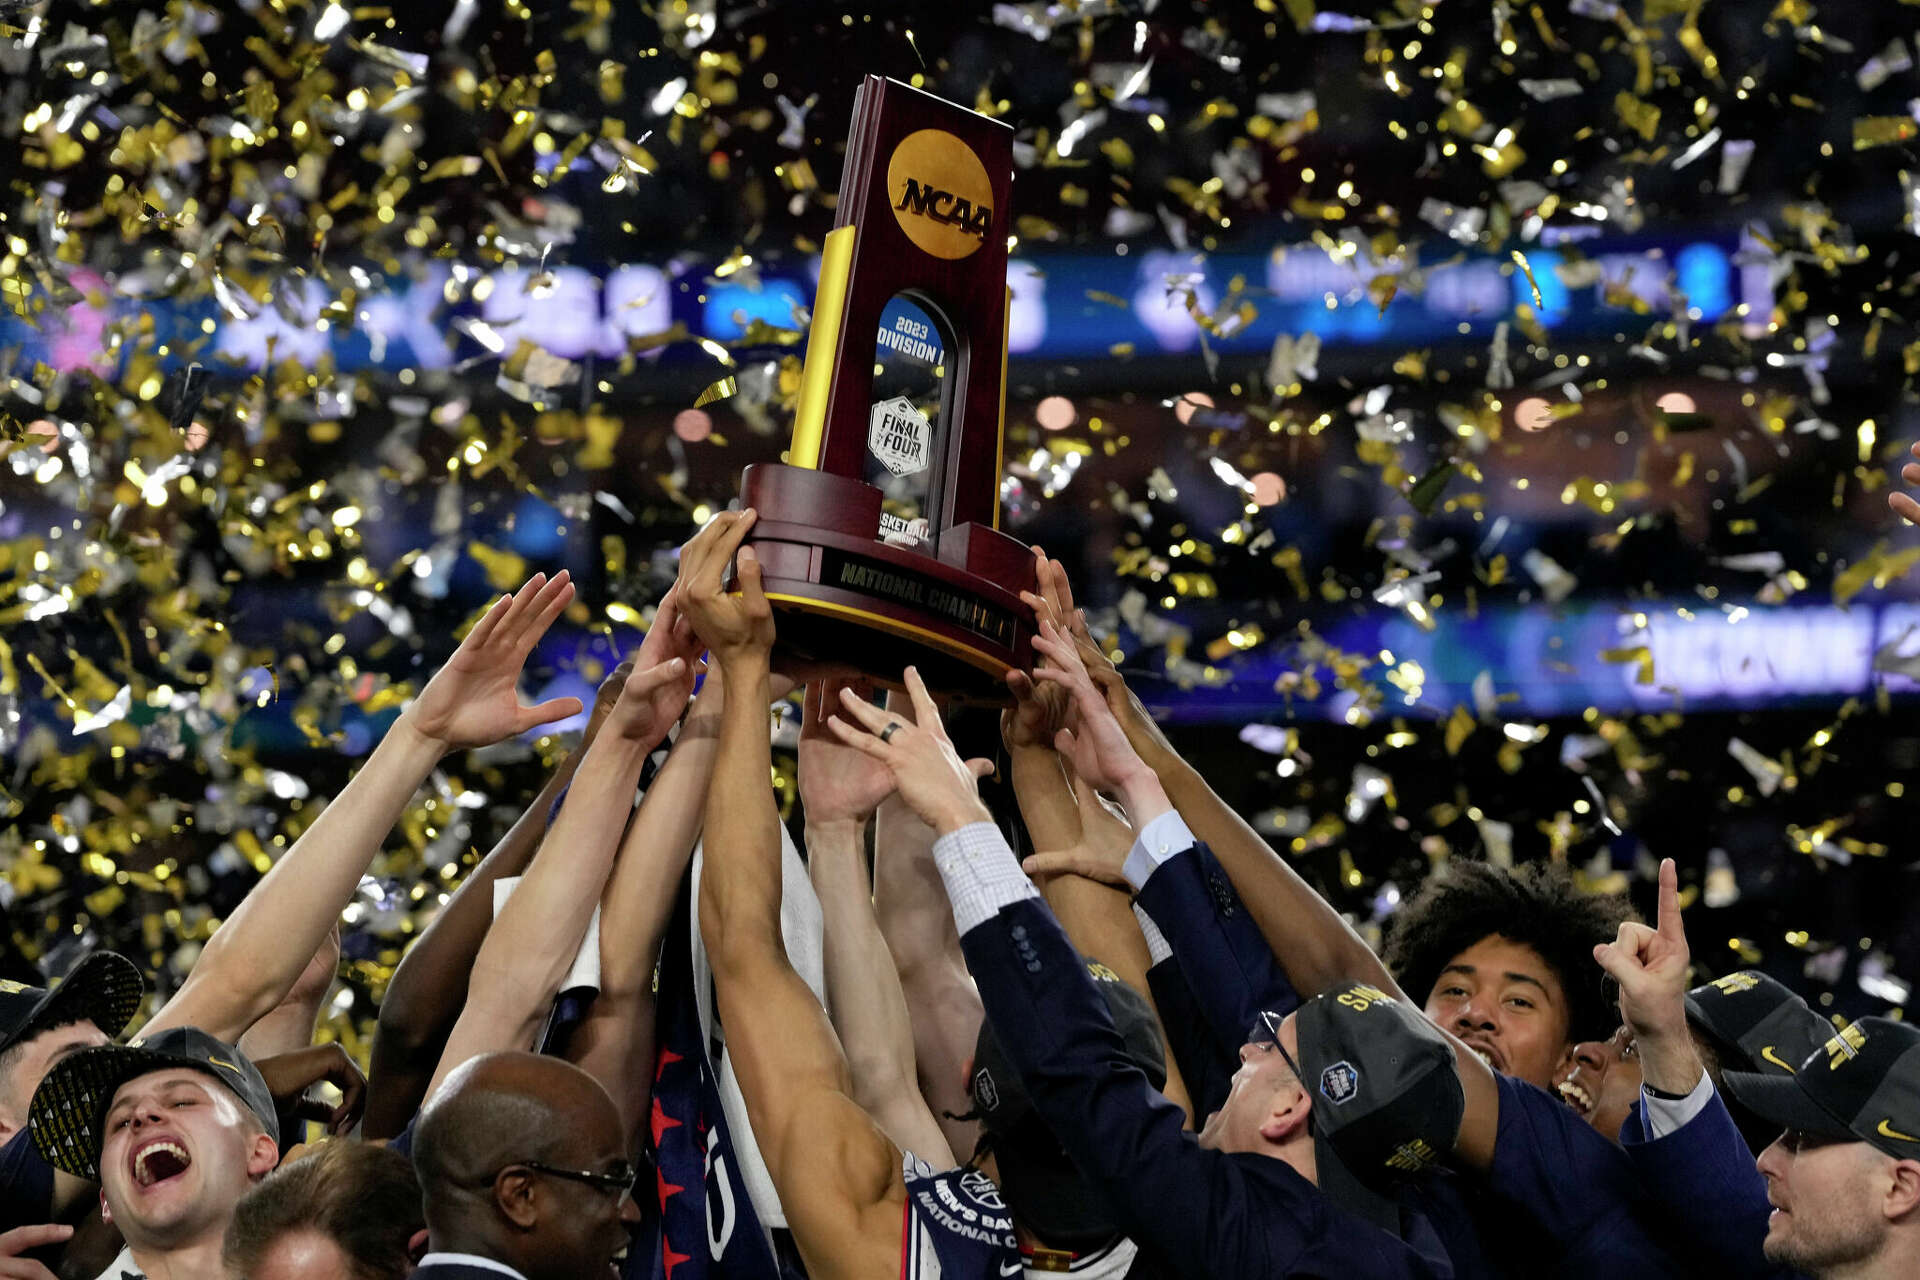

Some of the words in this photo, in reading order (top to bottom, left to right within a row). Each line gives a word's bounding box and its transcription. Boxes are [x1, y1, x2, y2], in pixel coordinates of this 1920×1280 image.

[894, 178, 992, 241] NCAA
[877, 327, 936, 364] DIVISION
[896, 316, 928, 340] 2023
[882, 413, 920, 441] FINAL
[884, 433, 921, 457] FOUR
[880, 512, 930, 542] SKETBALL
[841, 562, 924, 603] NATIONAL
[917, 1191, 1002, 1246] NATIONAL
[935, 1179, 978, 1222] MEN'S
